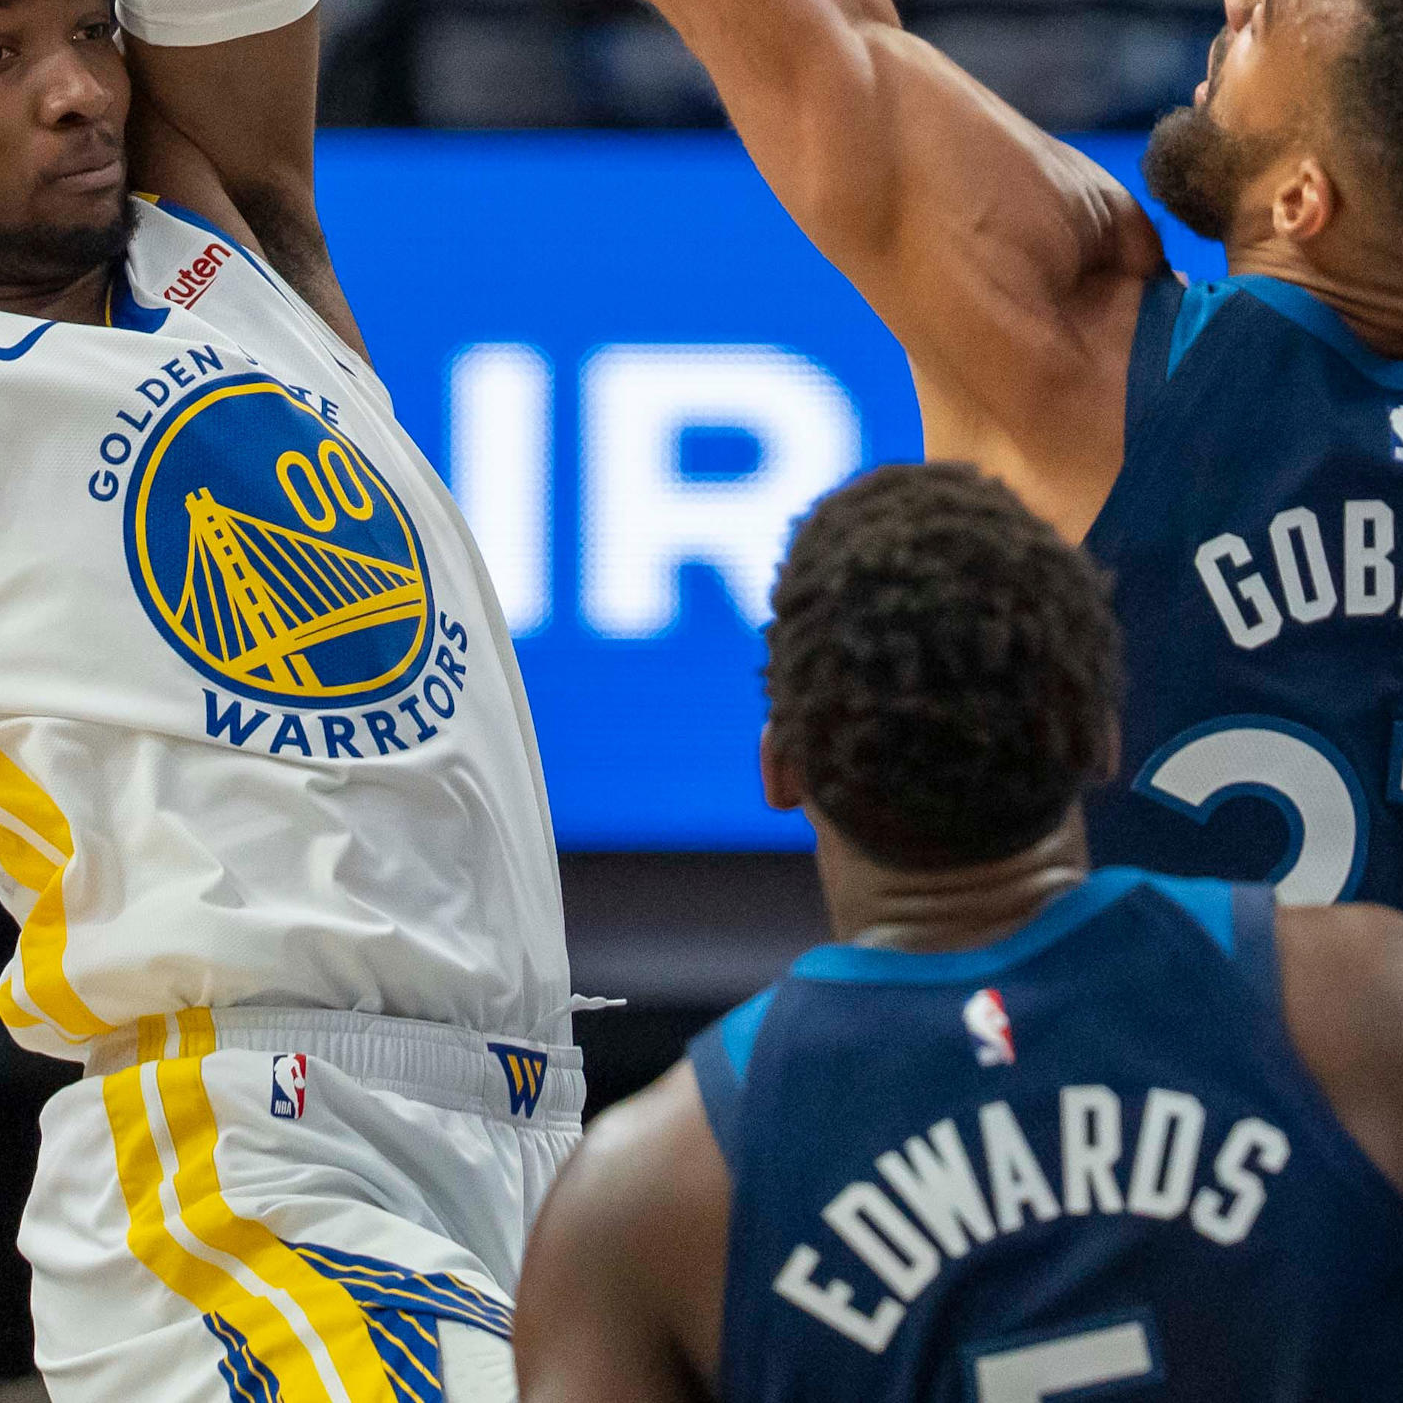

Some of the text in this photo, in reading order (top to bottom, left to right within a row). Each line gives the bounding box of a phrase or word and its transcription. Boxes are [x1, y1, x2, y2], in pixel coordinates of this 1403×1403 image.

[88, 344, 223, 503] GOLDEN
[275, 439, 375, 533] 00
[202, 610, 469, 759] WARRIORS
[772, 1083, 1291, 1355] EDWARDS
